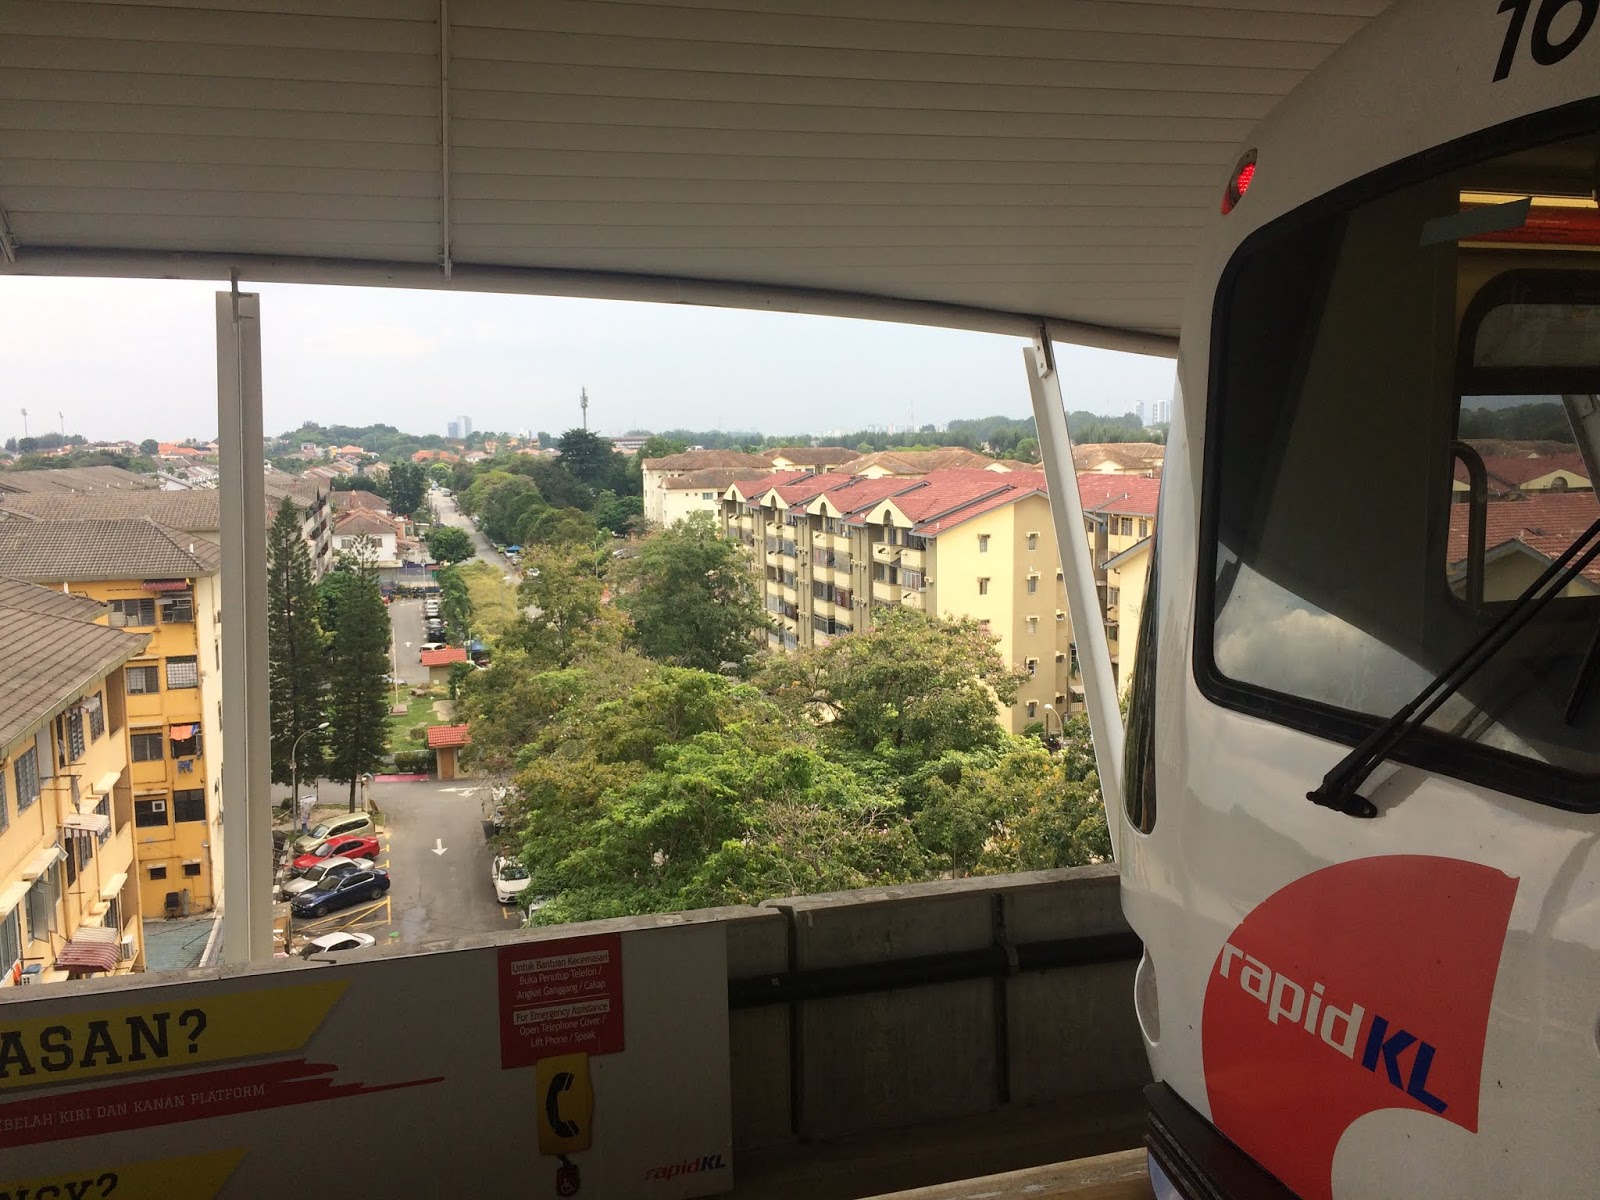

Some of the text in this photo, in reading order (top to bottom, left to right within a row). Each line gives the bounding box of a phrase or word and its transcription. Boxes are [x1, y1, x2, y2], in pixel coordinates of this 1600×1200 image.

[512, 952, 608, 973] Untuk Bantuan Kecemasan
[519, 976, 538, 986] Buka
[539, 971, 570, 983] Penutup
[570, 966, 597, 978] Telefon
[516, 988, 542, 1000] Angkat
[543, 984, 578, 996] Ganggang
[584, 980, 606, 990] Cakap
[516, 1003, 608, 1023] For Emergency Assistance
[519, 1025, 540, 1037] Open
[541, 1019, 578, 1032] Telephone
[579, 1016, 601, 1027] Cover
[0, 1008, 207, 1078] ASAN?
[531, 1037, 544, 1047] Lift
[545, 1033, 569, 1046] Phone
[574, 1030, 596, 1042] Speak
[60, 1107, 92, 1124] KIRI
[97, 1102, 128, 1118] DAN
[133, 1094, 185, 1113] KANAN
[191, 1083, 266, 1105] PLATFORM
